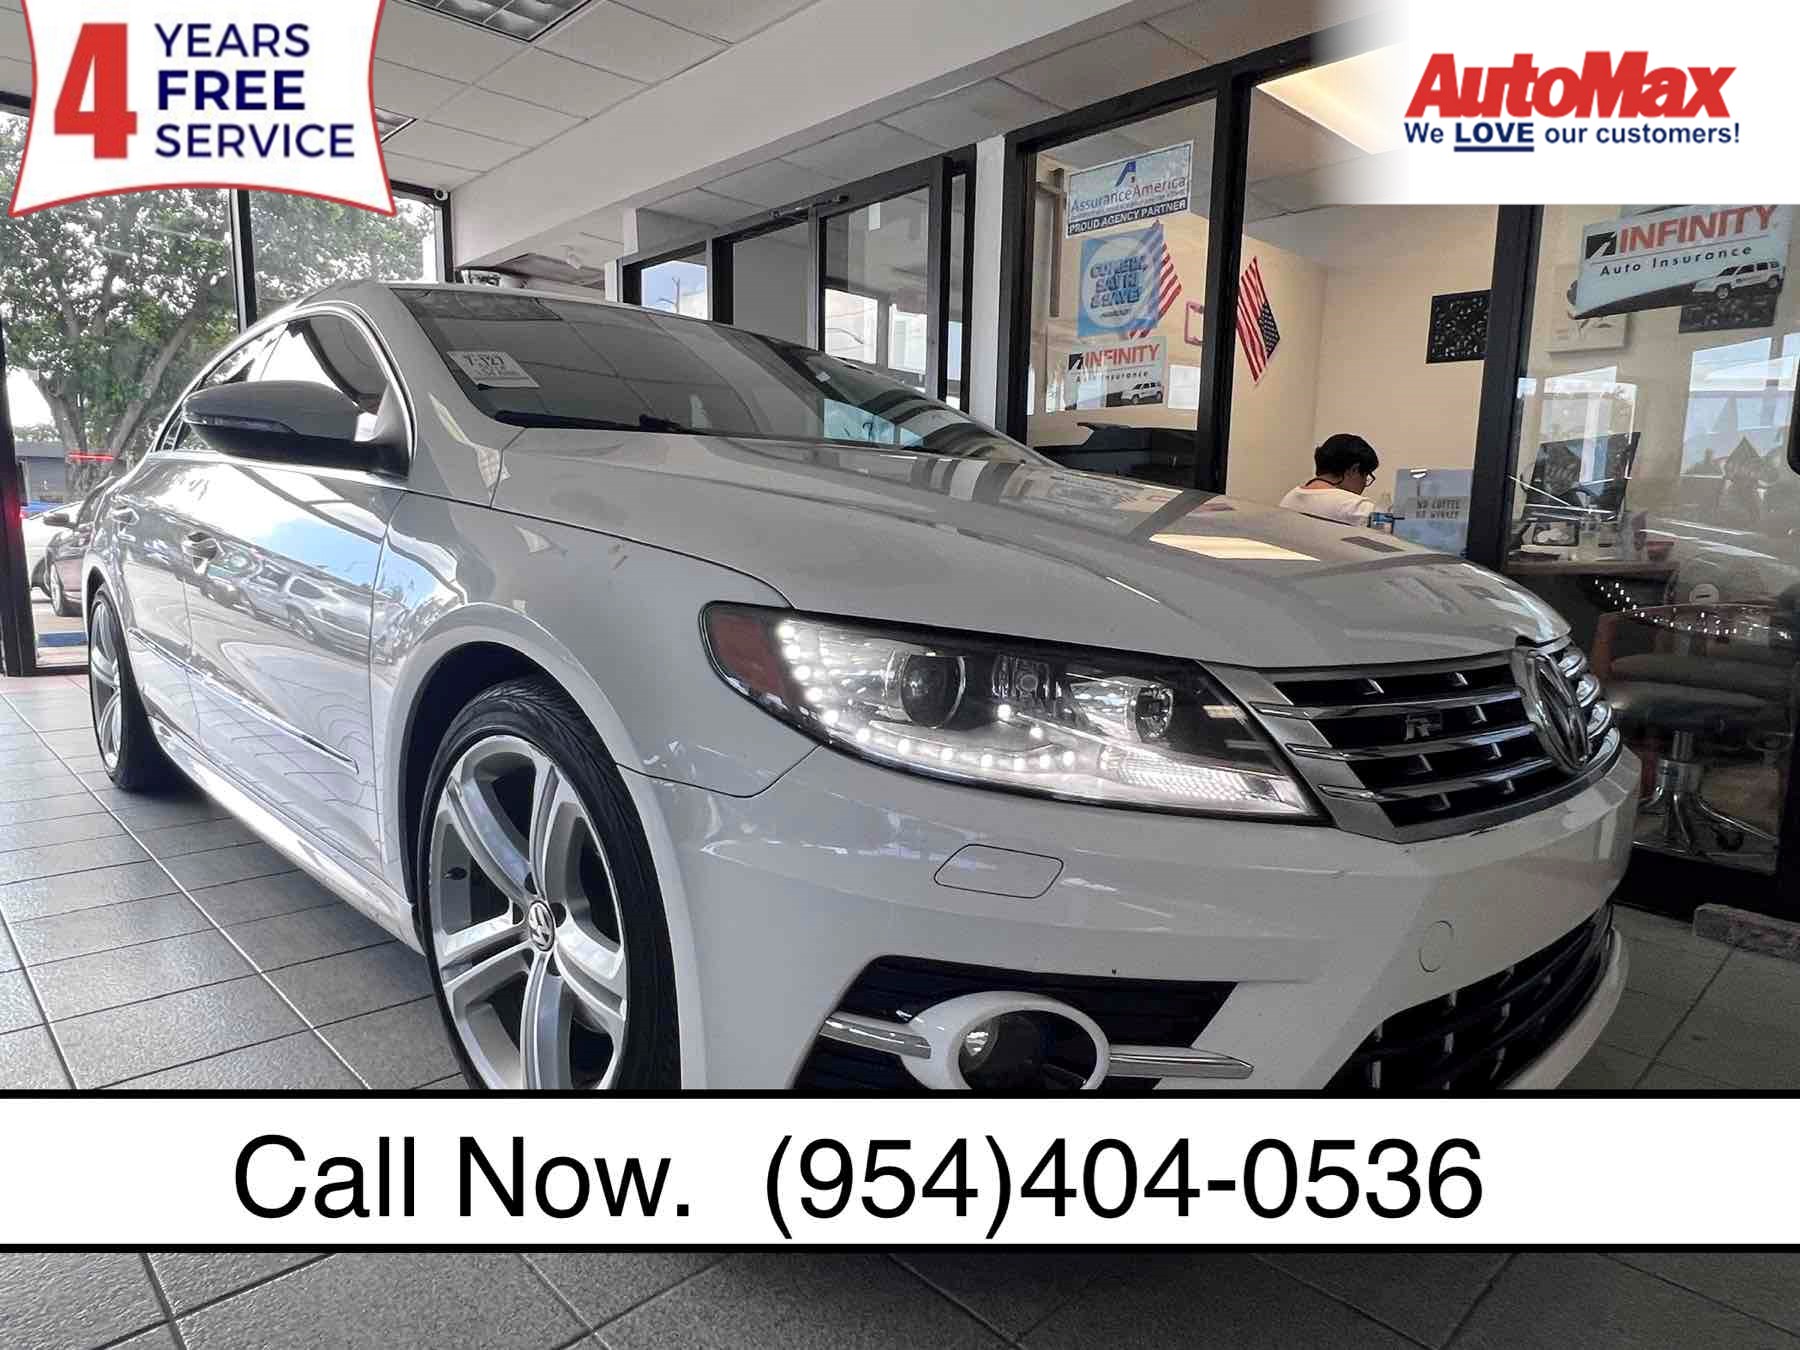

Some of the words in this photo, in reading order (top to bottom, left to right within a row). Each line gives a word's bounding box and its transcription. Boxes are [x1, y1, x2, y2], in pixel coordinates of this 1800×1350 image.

[1069, 220, 1101, 233] PROUD
[1100, 210, 1139, 227] AGENCY
[1140, 200, 1187, 218] PARTNER
[1620, 205, 1777, 253] INFINITY
[1600, 263, 1642, 277] Auto
[1652, 246, 1753, 269] Insurance
